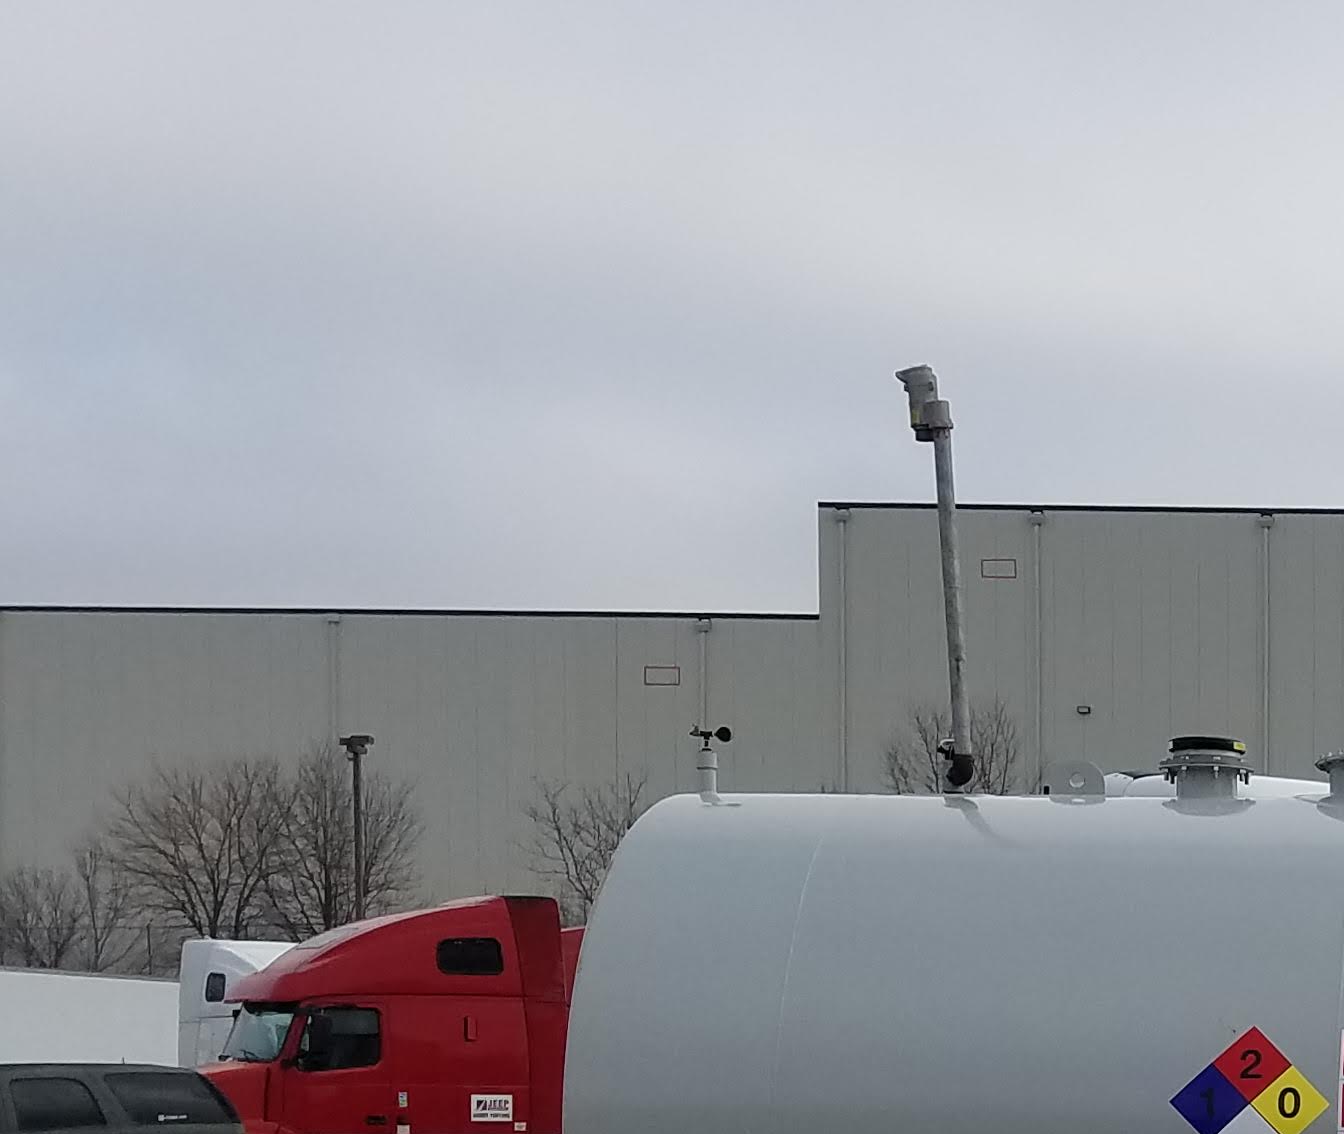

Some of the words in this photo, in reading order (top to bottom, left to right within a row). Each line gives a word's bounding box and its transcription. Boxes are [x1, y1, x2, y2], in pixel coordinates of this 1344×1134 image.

[1239, 1049, 1263, 1079] 2
[1200, 1087, 1216, 1119] 1
[1278, 1087, 1301, 1119] 0
